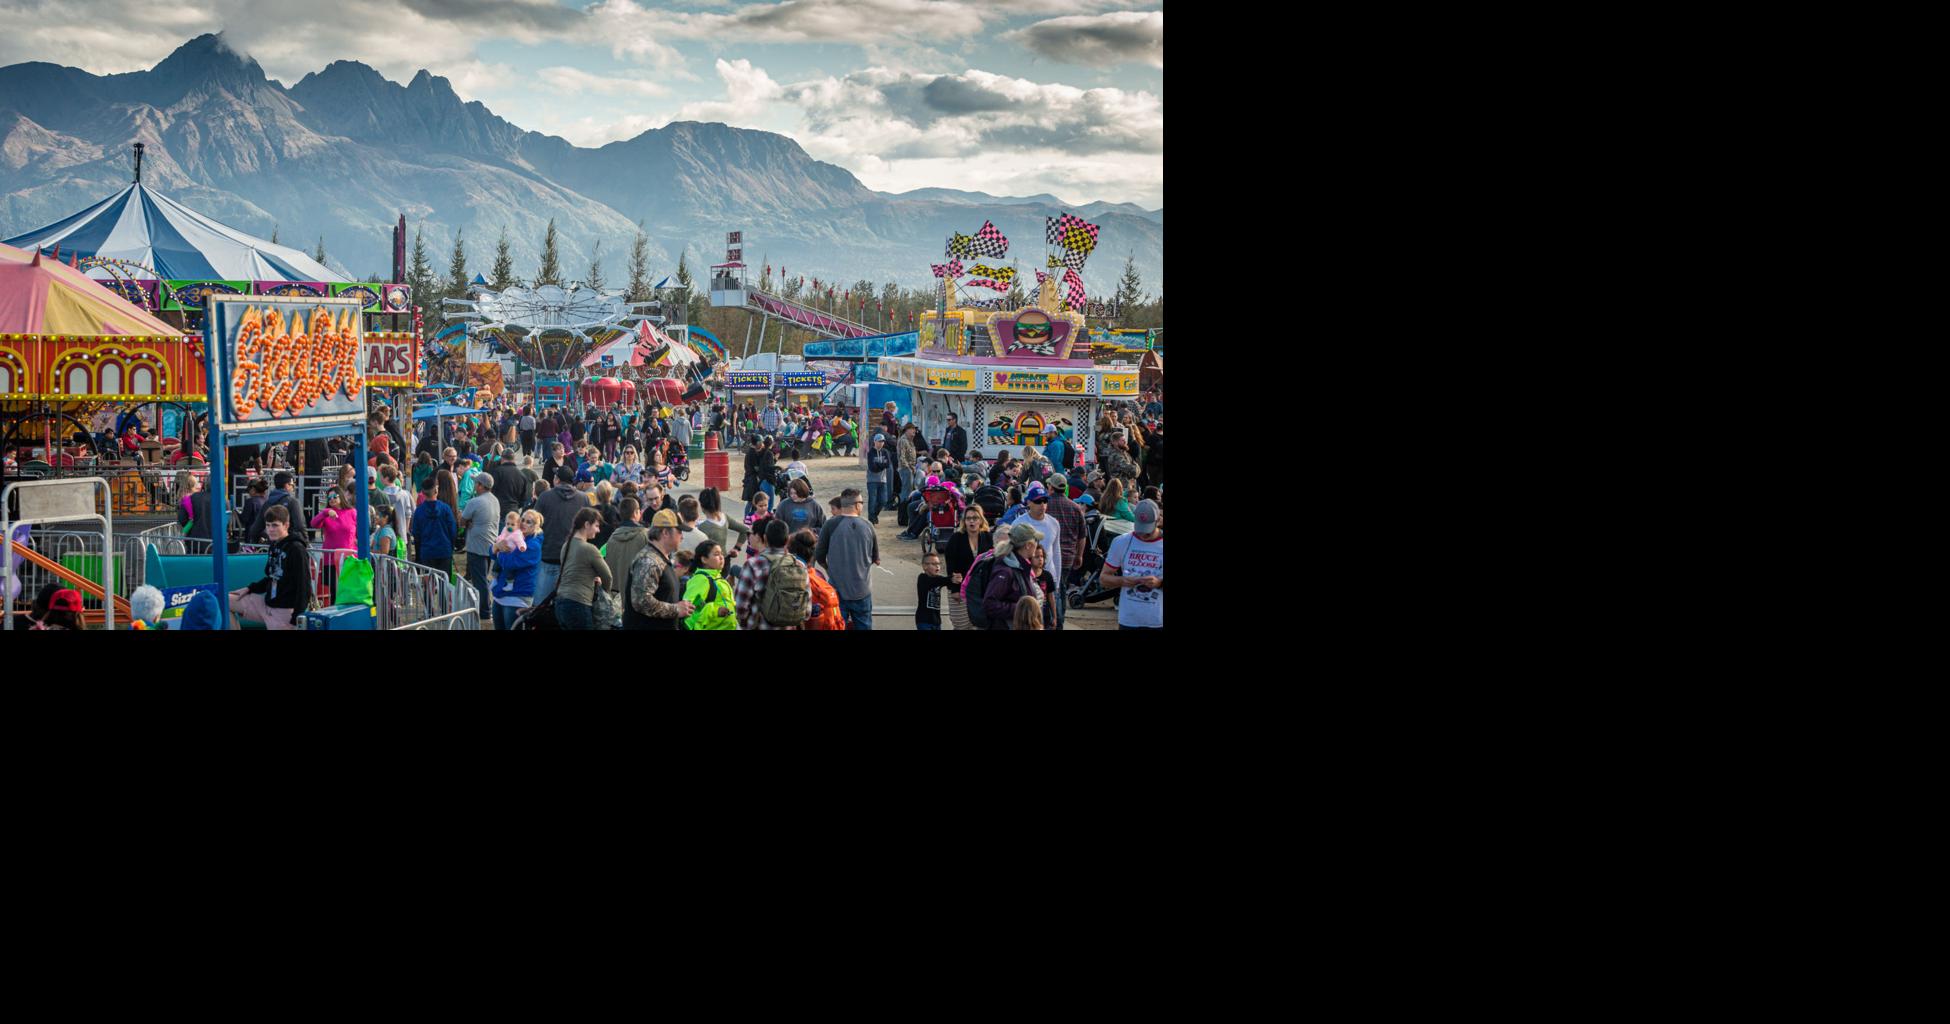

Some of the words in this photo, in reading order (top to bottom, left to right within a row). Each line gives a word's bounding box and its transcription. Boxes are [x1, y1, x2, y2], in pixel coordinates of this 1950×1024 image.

[231, 305, 364, 421] Sizzler
[364, 345, 411, 374] ARS
[733, 375, 769, 384] TICKETS
[787, 376, 823, 385] TICKETS
[939, 377, 970, 388] Water
[1129, 553, 1159, 562] BRUCE
[171, 589, 203, 606] Sizzl
